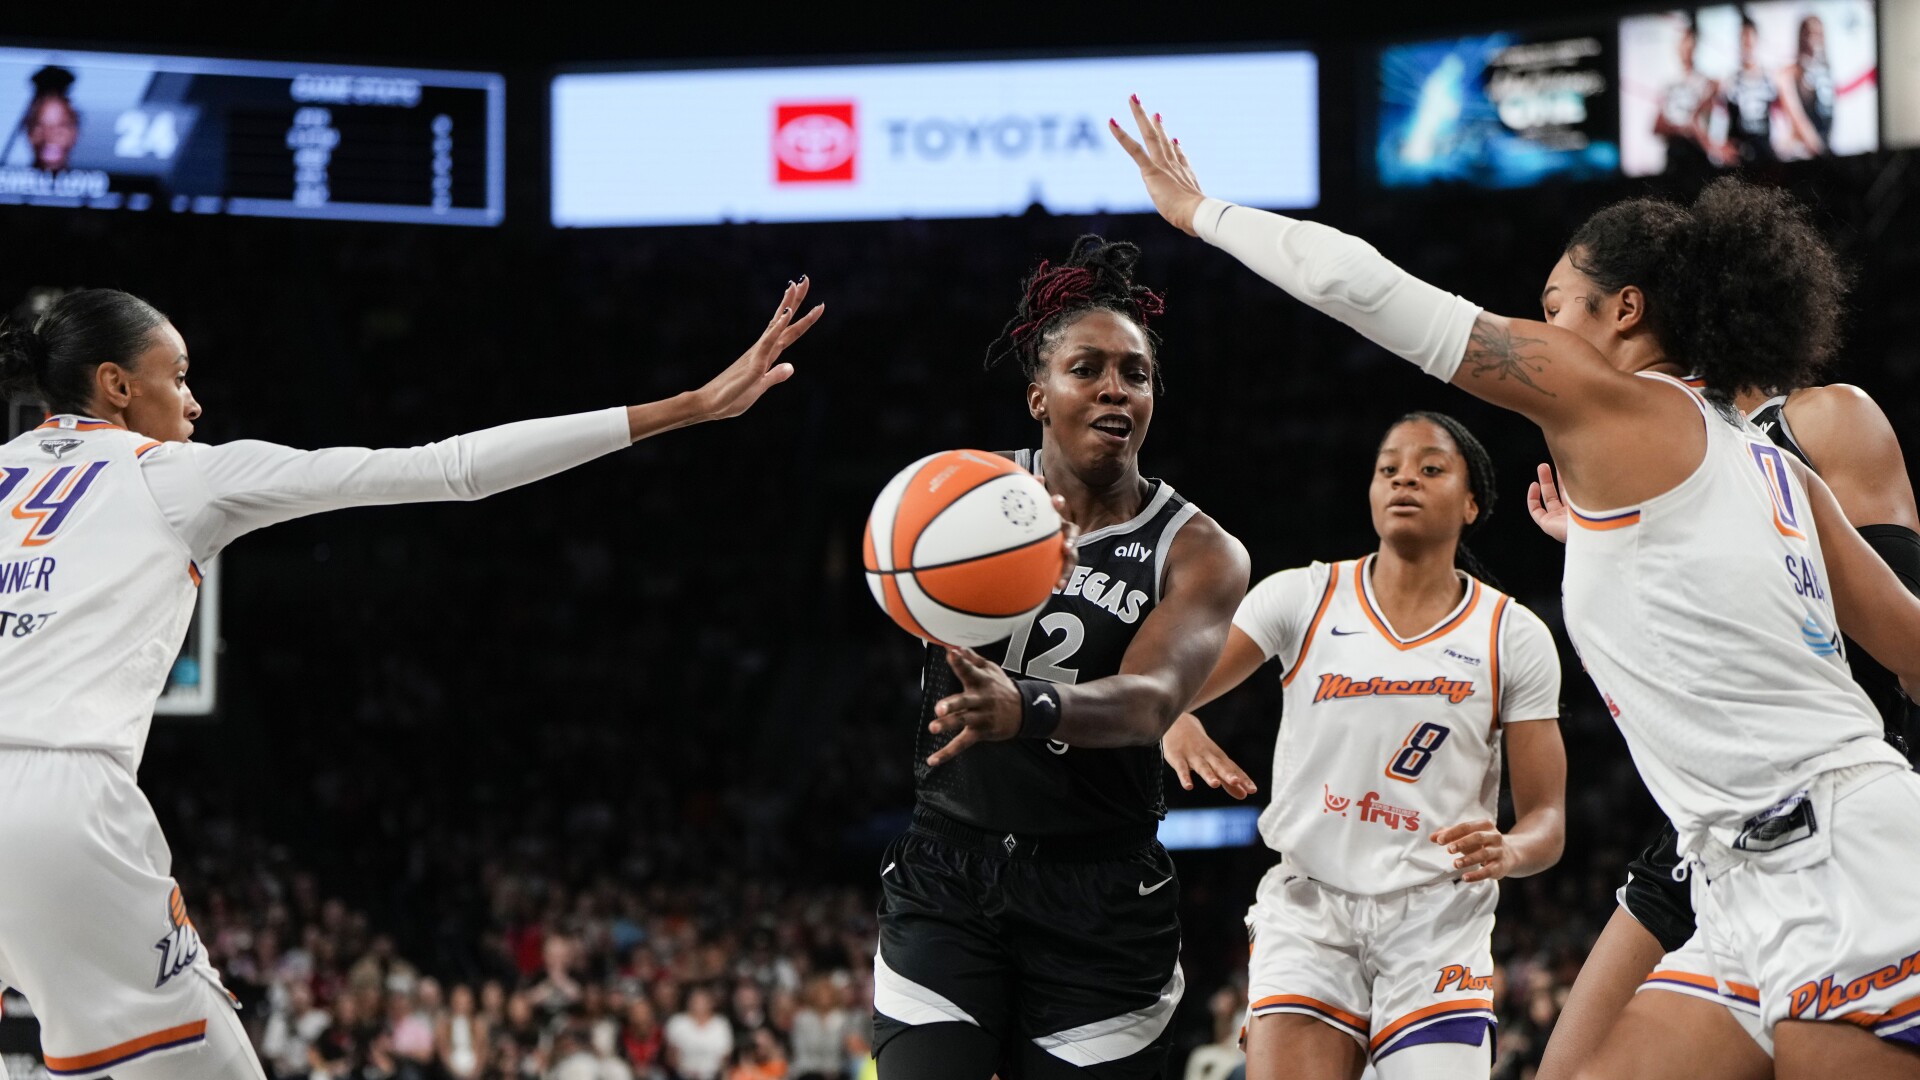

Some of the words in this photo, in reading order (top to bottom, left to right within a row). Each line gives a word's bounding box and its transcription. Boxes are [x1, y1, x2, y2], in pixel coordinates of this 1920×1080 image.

[114, 110, 179, 159] 24
[884, 116, 1106, 163] TOYOTA
[1746, 442, 1806, 541] 0
[1114, 542, 1153, 563] ally
[1052, 565, 1149, 624] EGAS
[1001, 612, 1085, 686] 12
[1312, 673, 1475, 704] Mercury
[1385, 721, 1450, 783] 8
[1356, 791, 1420, 832] fry's
